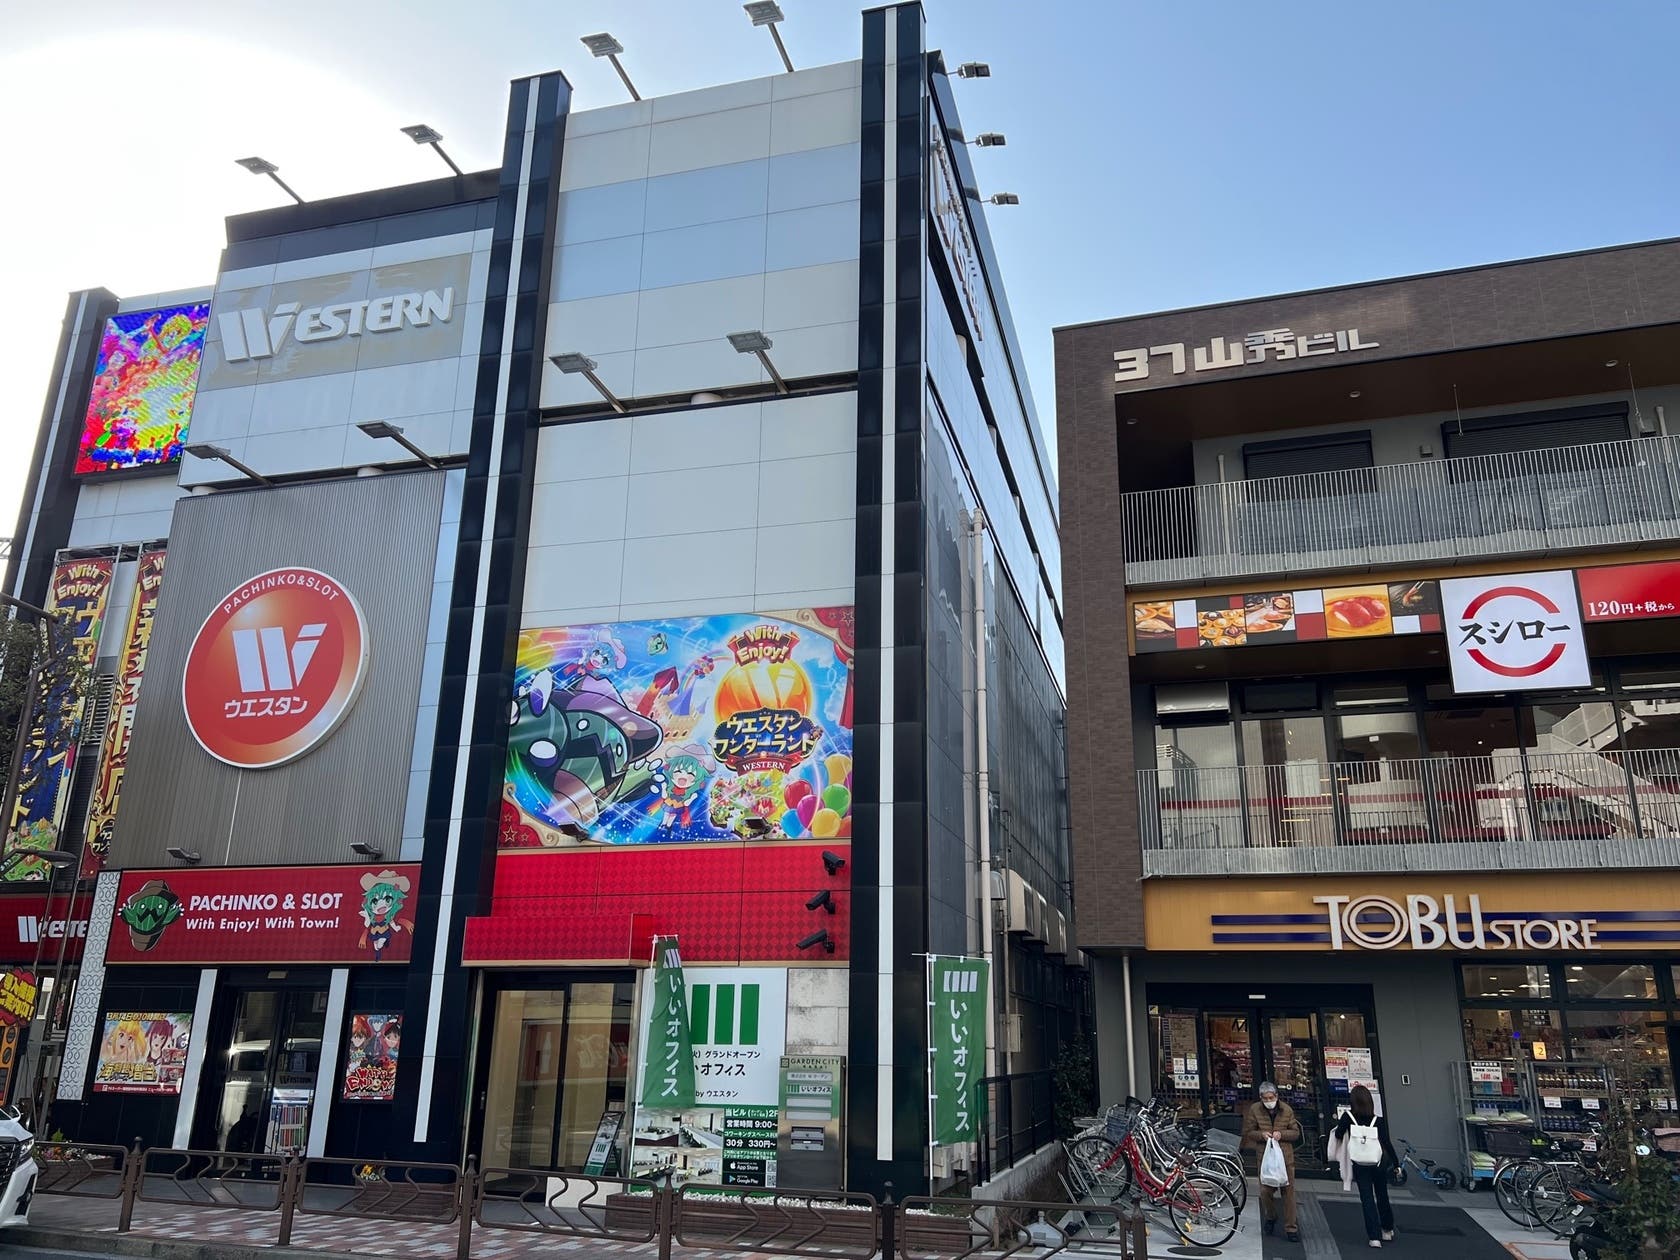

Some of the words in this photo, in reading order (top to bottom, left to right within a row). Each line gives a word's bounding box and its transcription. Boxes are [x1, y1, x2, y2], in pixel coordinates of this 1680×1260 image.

[217, 287, 455, 363] WESTERN
[1113, 328, 1380, 383] 37山秀ビル
[68, 563, 101, 581] With
[56, 581, 103, 600] Enjoy!
[747, 625, 783, 643] With
[1458, 619, 1571, 647] スシロー
[736, 643, 790, 664] Enjoy!
[224, 696, 308, 719] ウエスタン
[726, 713, 803, 736] ウエスタン
[714, 733, 816, 757] ワンダーランド
[742, 758, 787, 771] WESTERN
[189, 894, 278, 911] PACHINKO
[282, 893, 296, 910] &
[301, 893, 343, 910] SLOT
[186, 918, 215, 930] With
[219, 918, 260, 933] Enjoy!
[265, 917, 295, 929] With
[300, 917, 340, 929] Town!
[1312, 893, 1487, 951] TOBU
[1488, 918, 1601, 950] STORE
[661, 974, 682, 1097] いいオフィス
[705, 1051, 761, 1059] グランドオープン
[950, 999, 970, 1132] いいオフィス
[706, 1090, 738, 1098] ウエスタン
[726, 1139, 744, 1147] 30分
